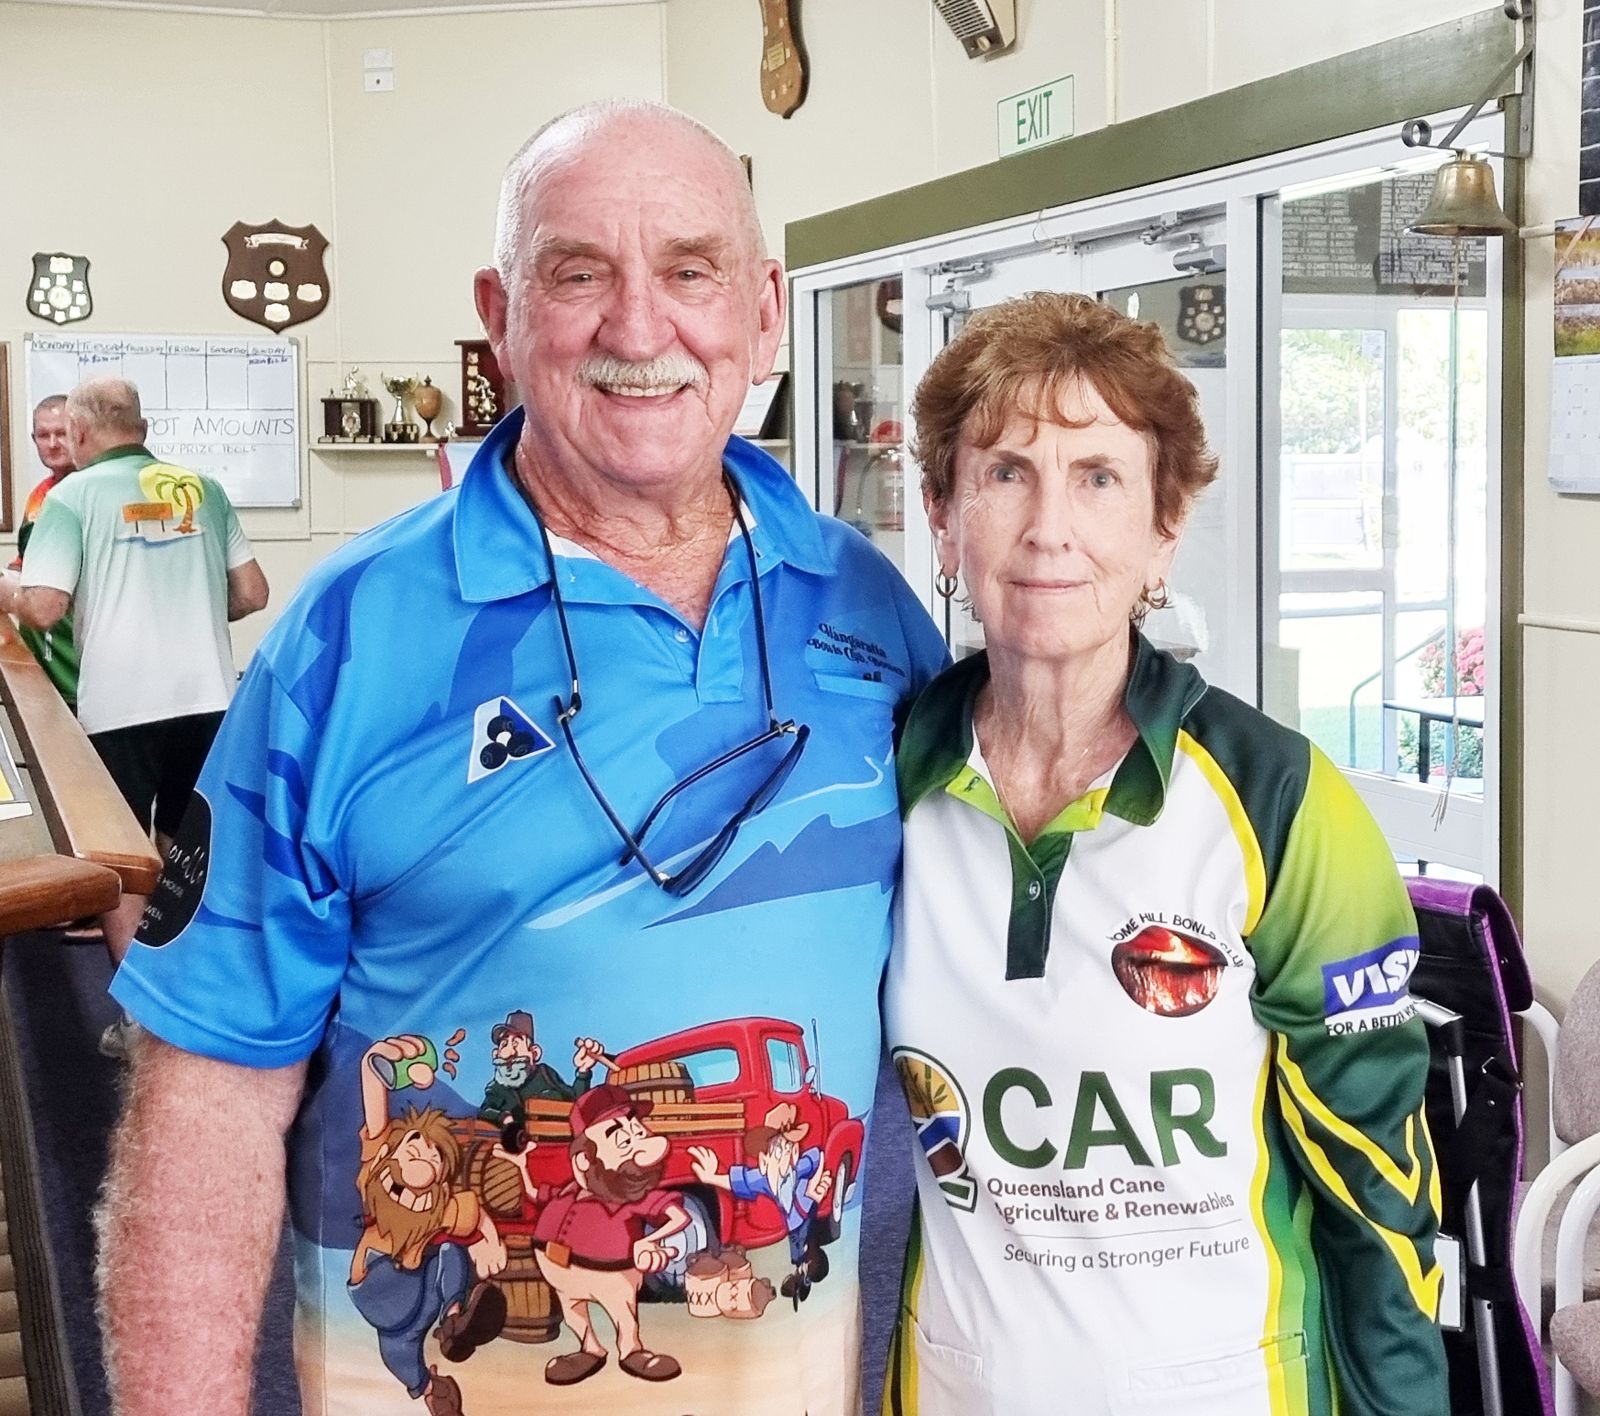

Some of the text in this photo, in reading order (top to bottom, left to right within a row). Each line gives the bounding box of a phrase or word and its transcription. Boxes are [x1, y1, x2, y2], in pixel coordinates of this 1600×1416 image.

[1016, 90, 1053, 145] EXIT
[32, 339, 76, 350] MONDAY
[192, 415, 294, 437] AMOUNTS
[149, 443, 175, 456] AILY
[1138, 911, 1169, 925] HILL
[1332, 949, 1420, 1008] VISY
[1326, 1021, 1354, 1036] FOR
[1359, 1019, 1368, 1031] A
[982, 1066, 1228, 1170] CAR
[987, 1178, 1166, 1199] Queensland Cane
[1105, 1203, 1119, 1221] &
[1125, 1191, 1235, 1219] Renewables
[1082, 1255, 1094, 1269] a
[1098, 1244, 1184, 1269] Stronger
[1189, 1236, 1250, 1259] Future
